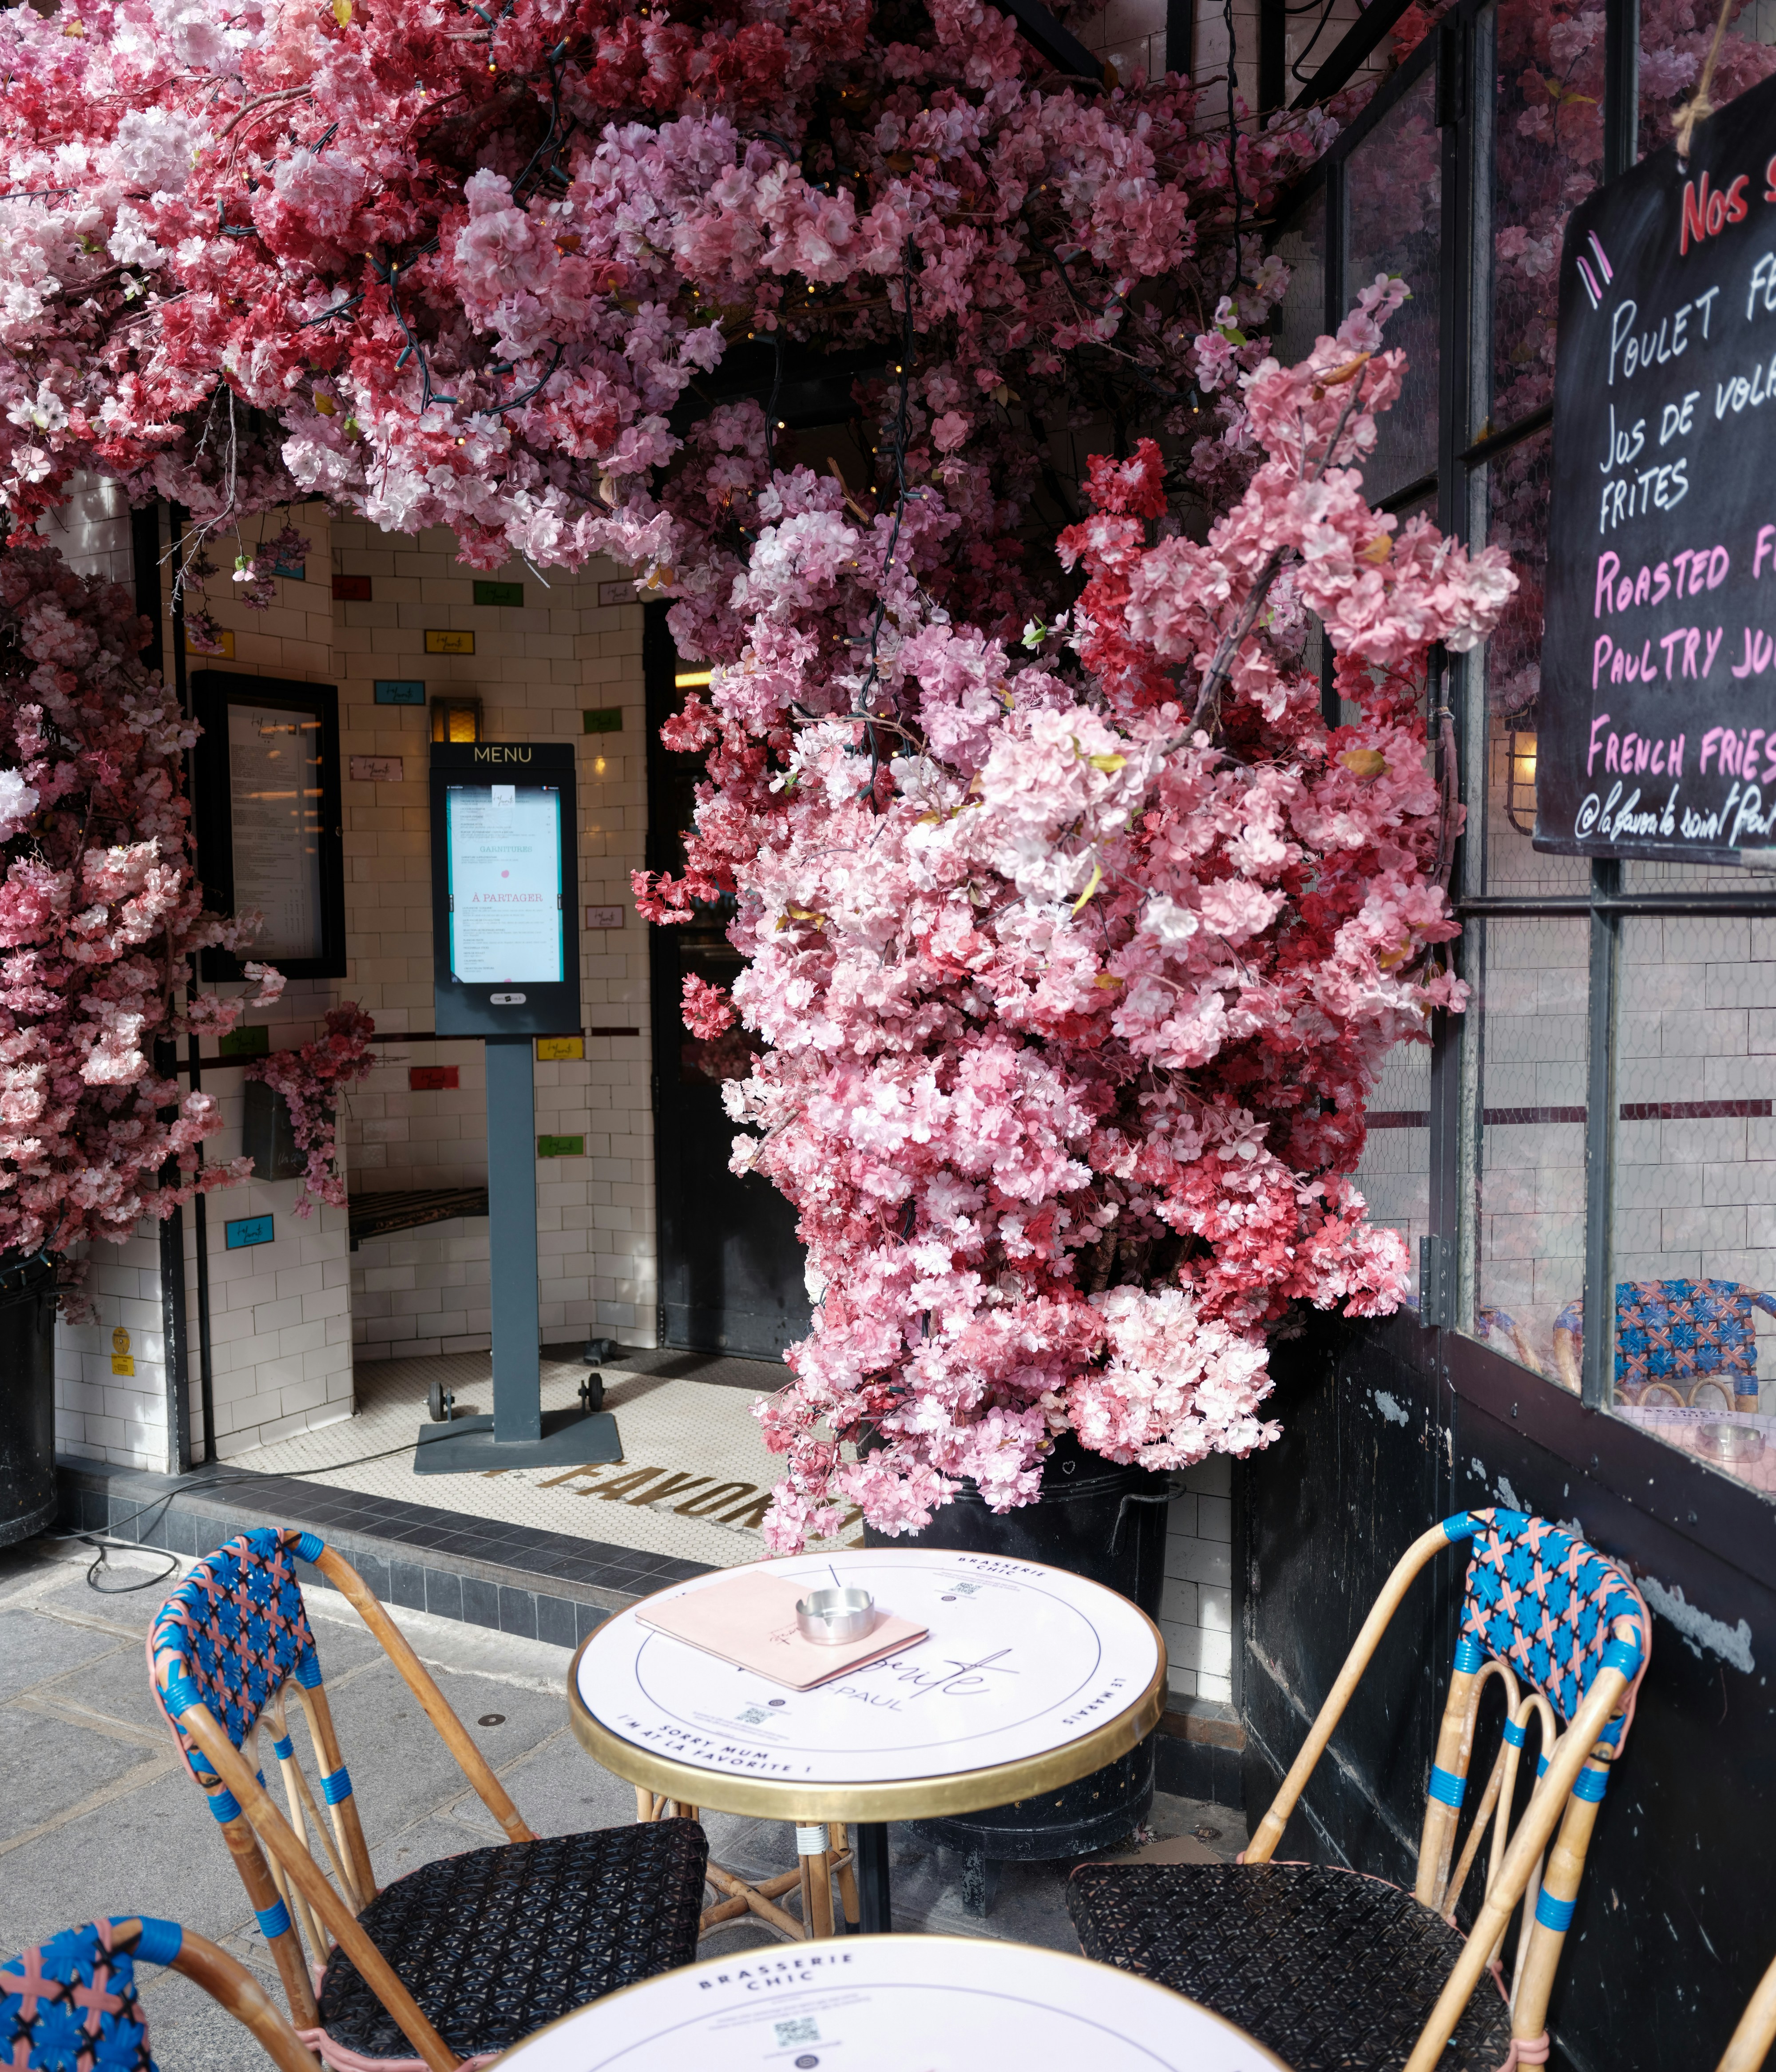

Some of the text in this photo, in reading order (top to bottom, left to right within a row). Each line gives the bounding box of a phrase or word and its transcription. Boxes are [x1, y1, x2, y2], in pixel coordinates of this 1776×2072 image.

[1608, 285, 1719, 385] POULET
[1600, 403, 1645, 473] JUS
[1660, 391, 1700, 446] DE
[475, 747, 531, 762] MENU
[1587, 713, 1685, 777] FRENCH
[472, 892, 543, 902] À PARTAGER
[958, 1557, 1046, 1577] BRASSERIE
[976, 1565, 1015, 1576] CHIC
[1062, 1691, 1114, 1724] MARAIS
[641, 1731, 662, 1741] AT
[665, 1740, 685, 1751] LA
[693, 1750, 792, 1772] FAVORITE
[659, 1724, 716, 1747] SORRY
[721, 1746, 769, 1760] MUM
[699, 1954, 852, 1989] BRASSERIE
[747, 1971, 813, 1990] CHIC
